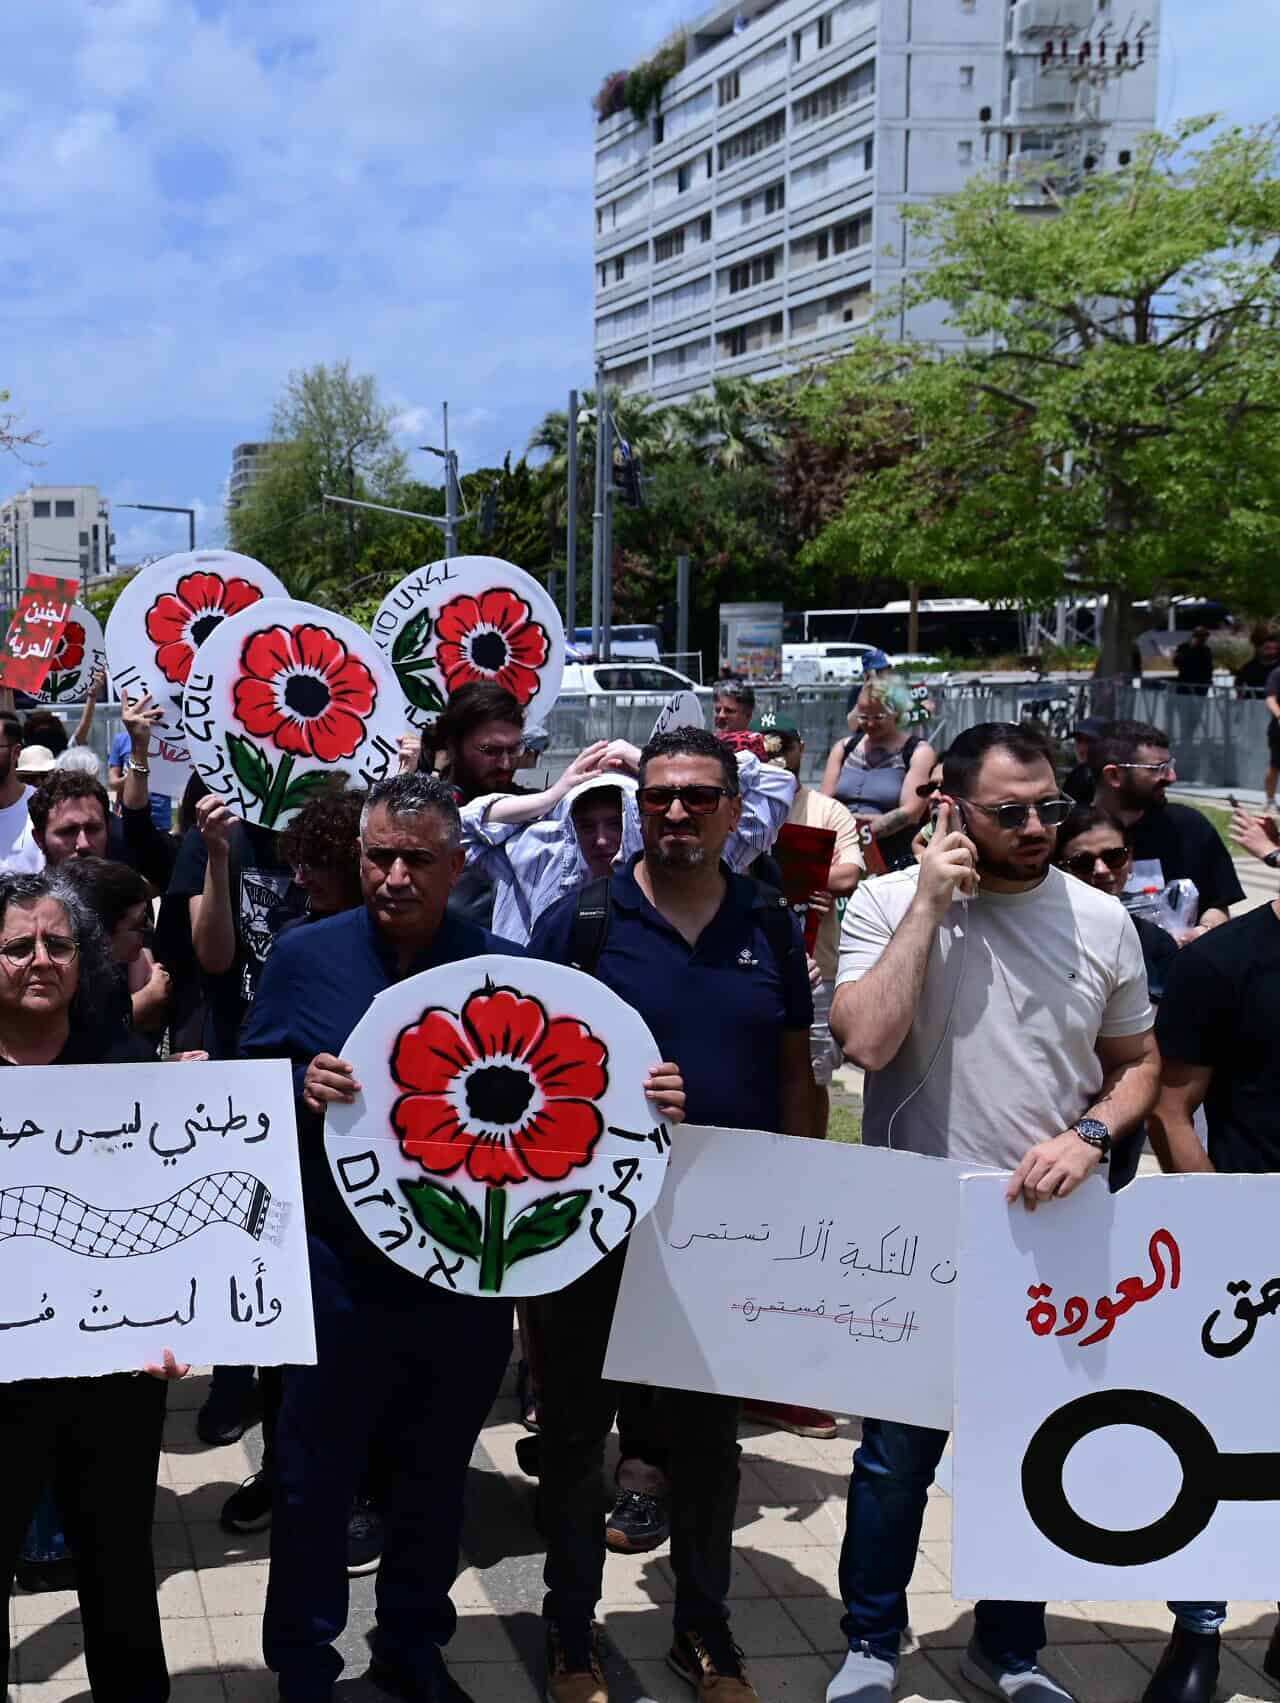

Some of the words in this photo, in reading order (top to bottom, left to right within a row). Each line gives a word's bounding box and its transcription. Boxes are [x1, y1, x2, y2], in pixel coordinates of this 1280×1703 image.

[9, 628, 54, 660] الحرية
[55, 1101, 141, 1155] ليس
[150, 1096, 271, 1167] وطني
[1026, 1228, 1181, 1347] العودة
